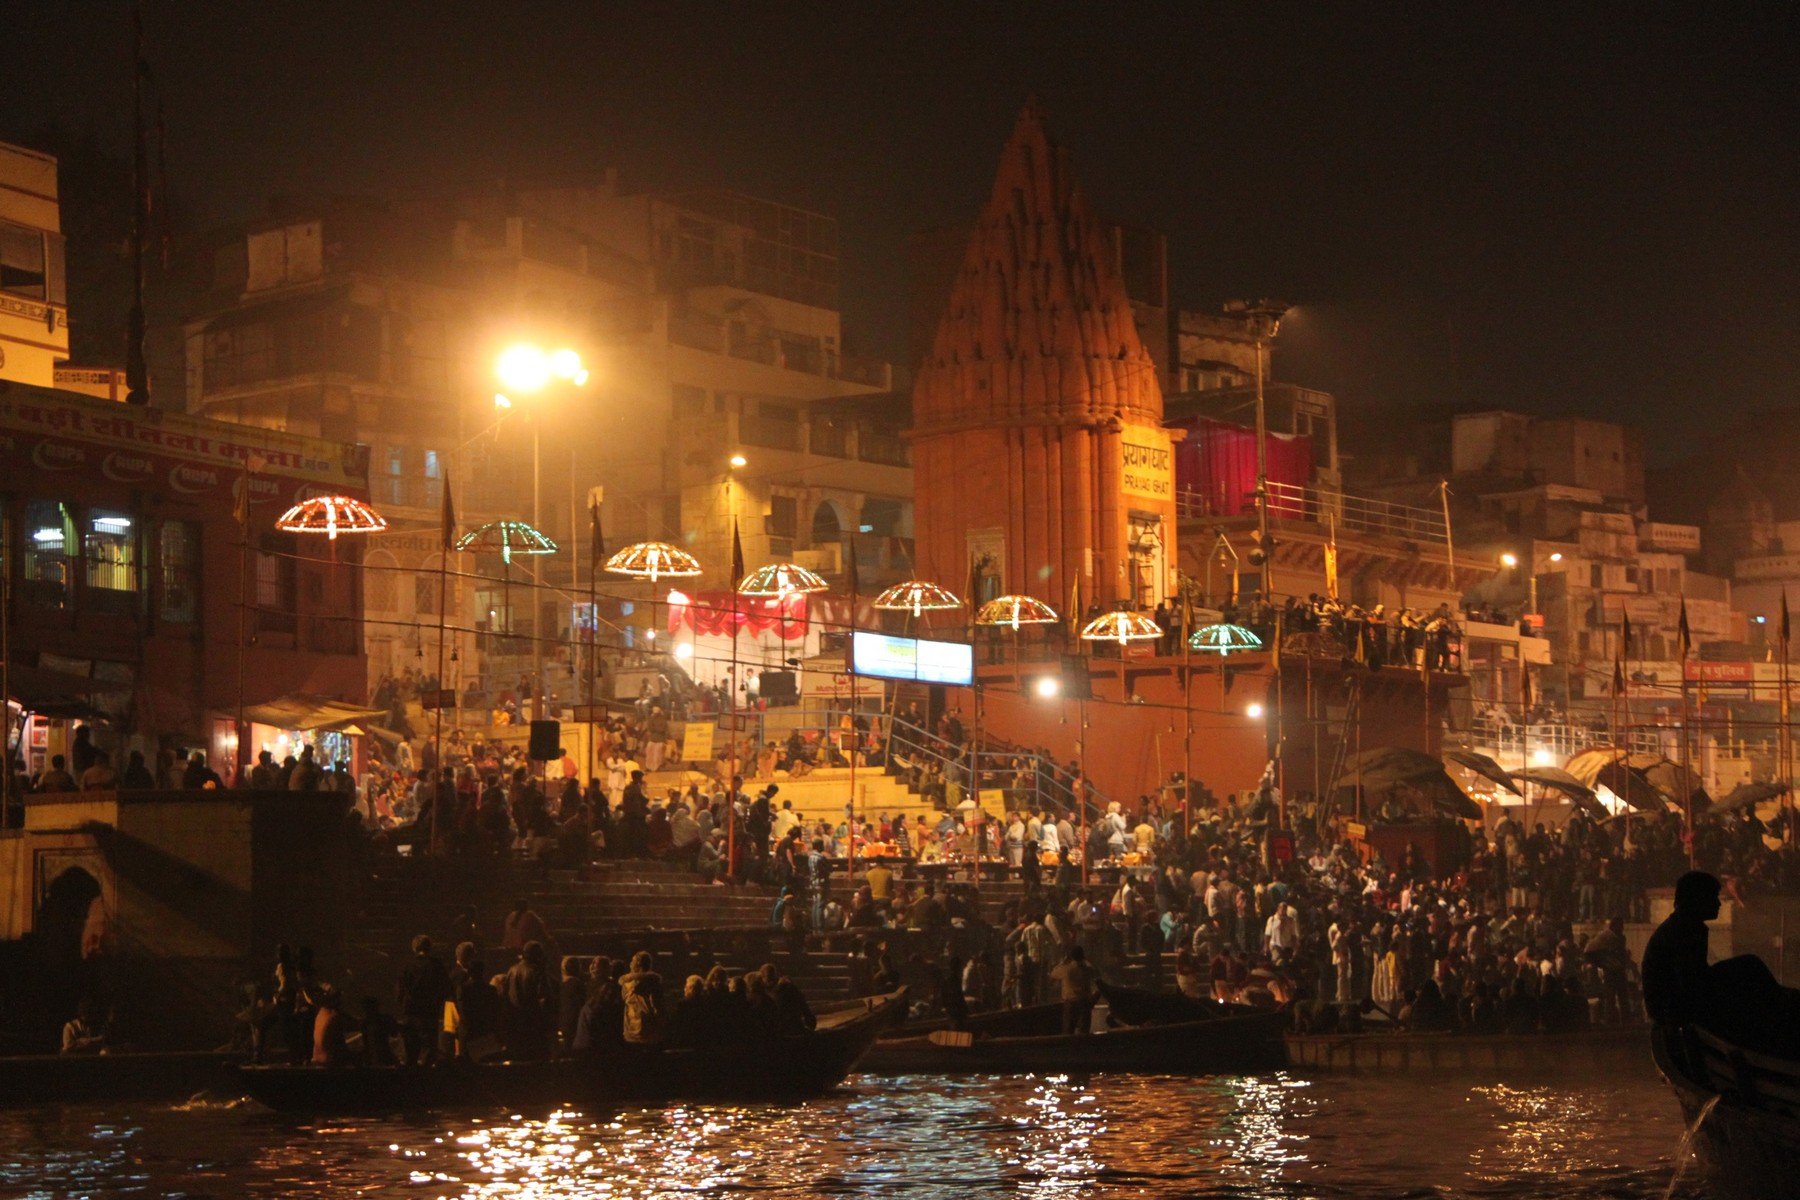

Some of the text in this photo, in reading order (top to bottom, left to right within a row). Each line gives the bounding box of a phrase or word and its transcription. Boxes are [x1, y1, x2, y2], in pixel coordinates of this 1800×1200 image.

[115, 455, 154, 475] RUPA
[1121, 441, 1169, 471] प्रयाग घाट
[181, 467, 218, 485] RUPA
[1124, 473, 1170, 495] PRAYAG GHAT
[248, 478, 279, 495] RUPA
